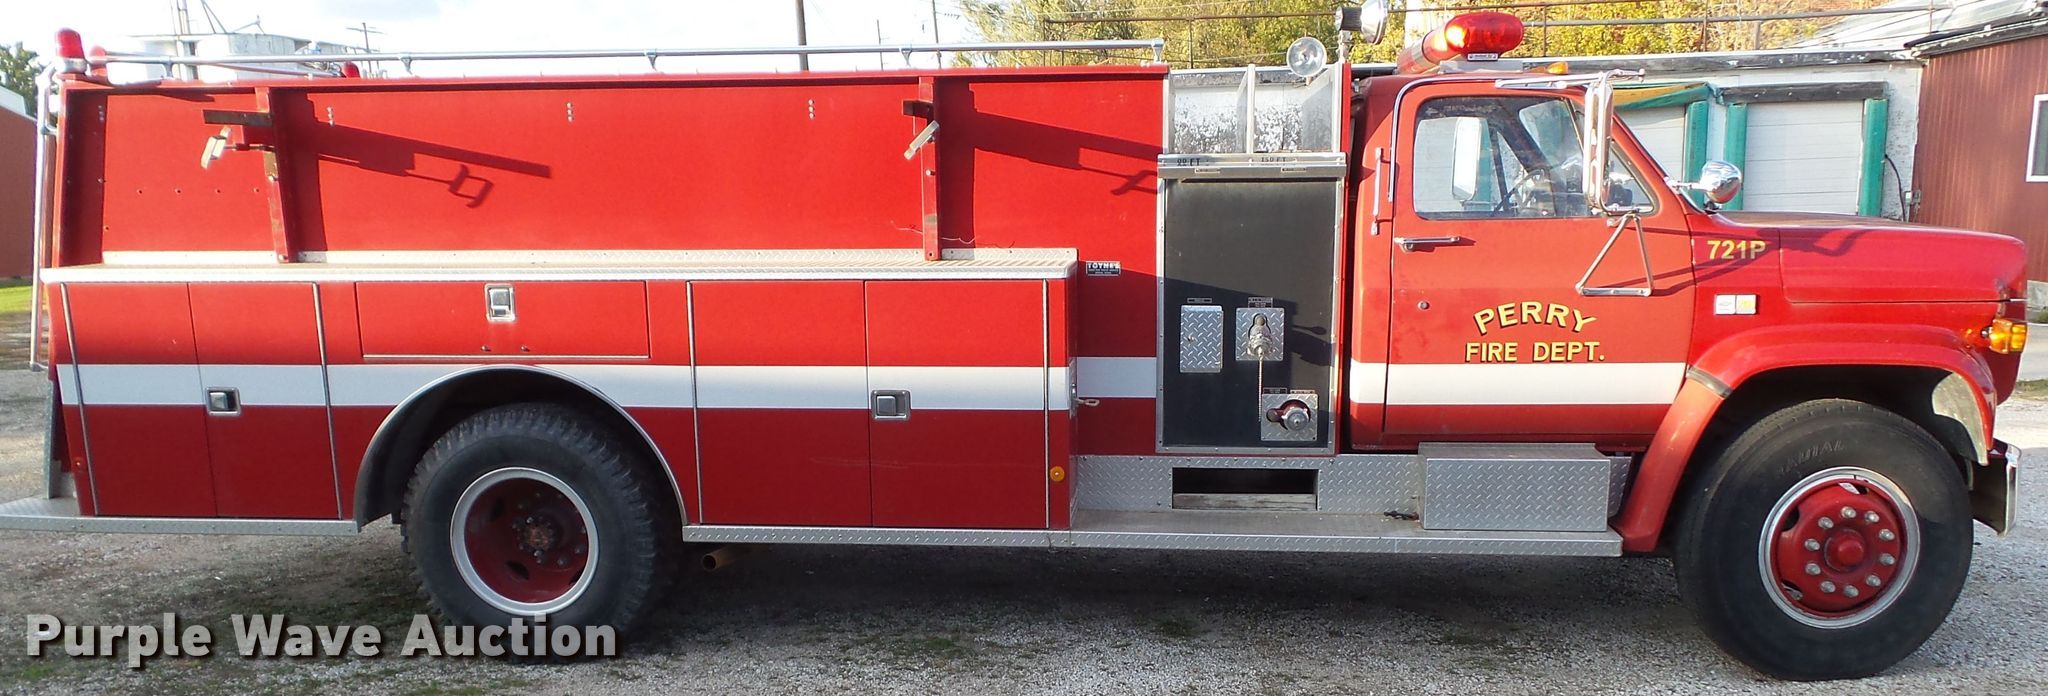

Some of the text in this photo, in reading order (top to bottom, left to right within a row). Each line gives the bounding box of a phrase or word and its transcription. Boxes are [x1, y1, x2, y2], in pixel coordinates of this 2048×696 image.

[1707, 240, 1766, 260] 721P
[1473, 301, 1597, 336] PERRY
[1465, 341, 1605, 362] FIRE DEPT.
